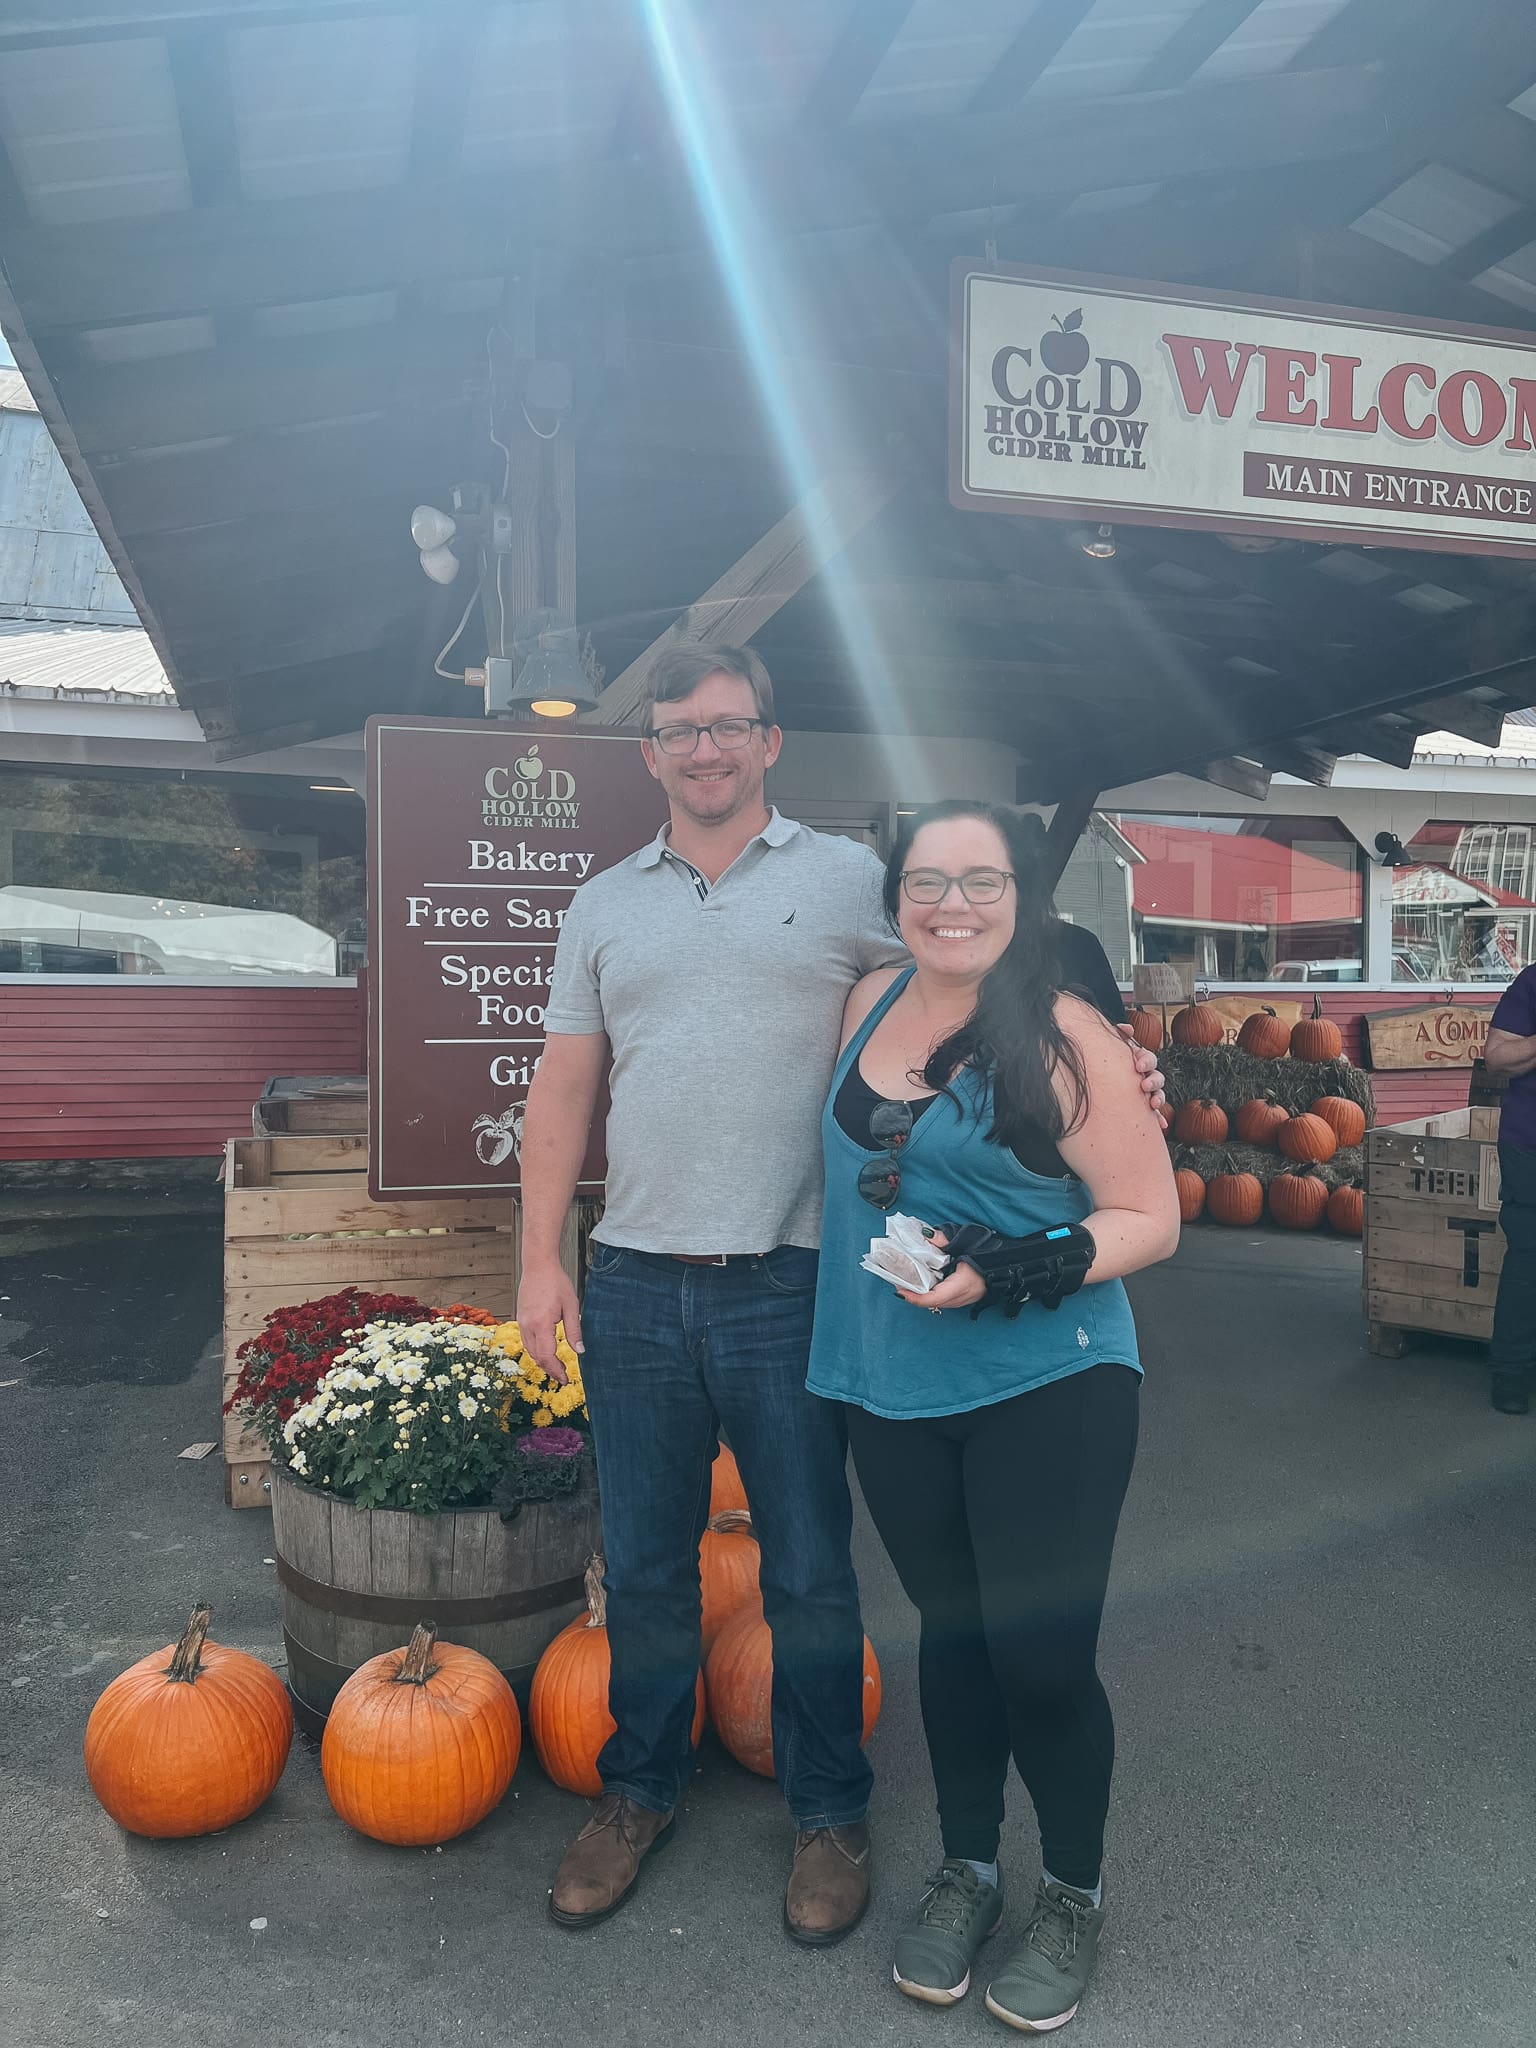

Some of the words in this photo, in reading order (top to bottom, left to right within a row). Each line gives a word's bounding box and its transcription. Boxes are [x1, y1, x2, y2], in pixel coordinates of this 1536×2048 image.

[991, 345, 1142, 418] COLD
[984, 405, 1149, 449] HOLLOW
[987, 436, 1073, 462] CIDER
[1082, 446, 1146, 470] MILL
[1265, 463, 1352, 497] MAIN
[1364, 472, 1533, 516] ENTRANCE
[484, 767, 576, 801] COLD
[481, 799, 580, 818] HOLLOW
[483, 816, 534, 828] CIDER
[541, 818, 580, 829] MILL
[467, 840, 595, 879] Bakery
[405, 896, 490, 928] Free
[477, 995, 546, 1026] Foo
[1415, 1022, 1431, 1042] A
